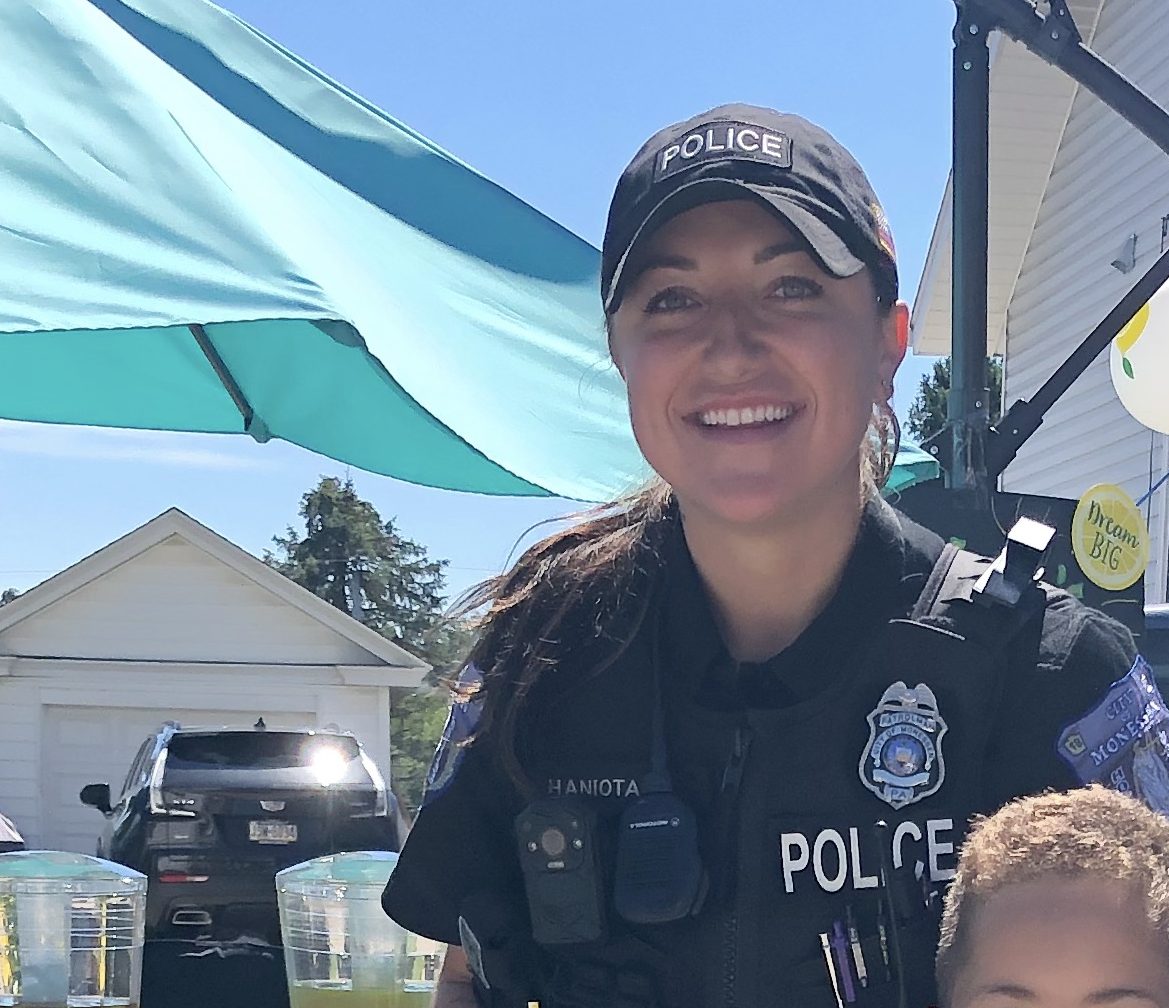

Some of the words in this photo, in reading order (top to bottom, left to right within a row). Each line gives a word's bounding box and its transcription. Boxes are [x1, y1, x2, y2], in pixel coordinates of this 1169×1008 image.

[660, 127, 783, 172] POLICE
[1087, 499, 1140, 549] Dream
[1088, 530, 1123, 571] BIG
[547, 778, 640, 797] HANIOTA
[780, 817, 956, 893] POLCE
